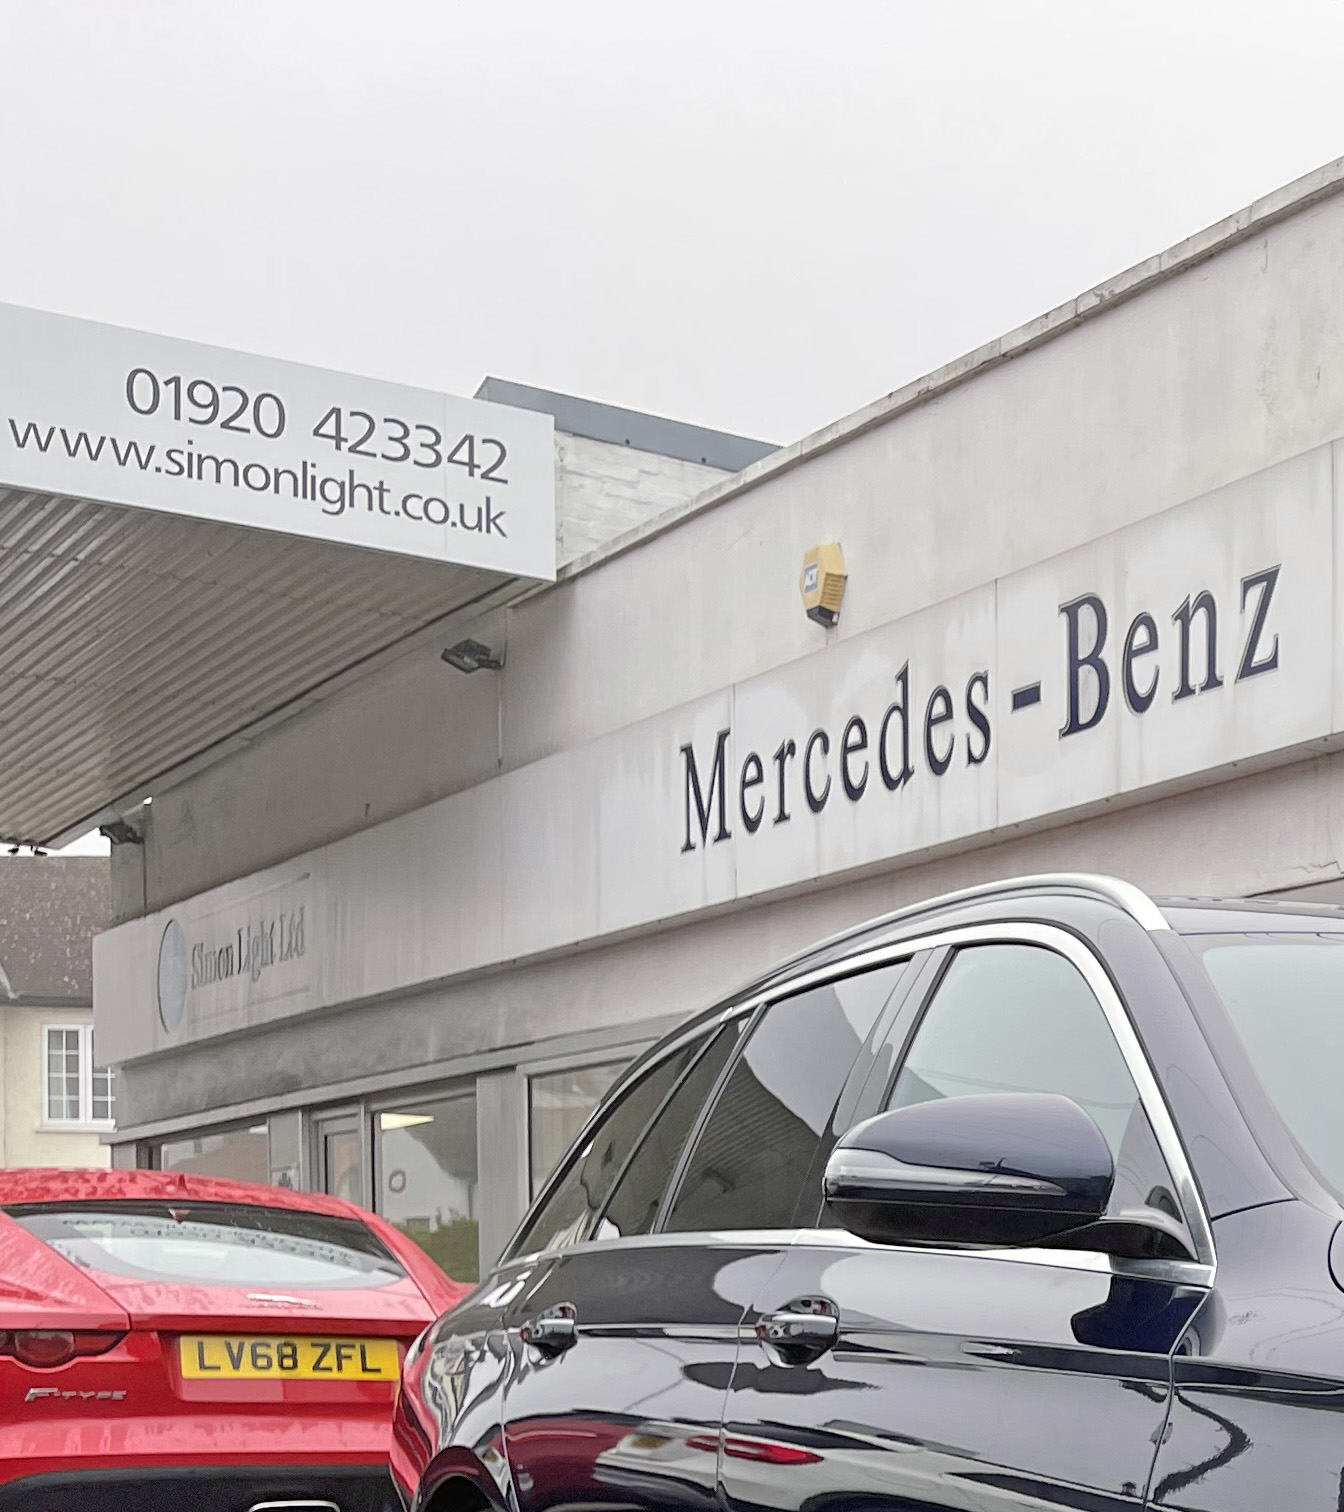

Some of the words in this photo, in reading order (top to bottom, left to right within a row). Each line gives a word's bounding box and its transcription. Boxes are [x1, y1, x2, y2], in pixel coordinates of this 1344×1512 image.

[8, 417, 507, 537] www.simonlight.co.uk
[125, 367, 286, 439] 01920
[312, 406, 509, 484] 423342
[680, 563, 1281, 854] Mercedes-Benz
[192, 941, 234, 990] Simon
[237, 921, 275, 983] Light
[199, 1340, 298, 1371] LV68
[312, 1343, 382, 1373] ZFL
